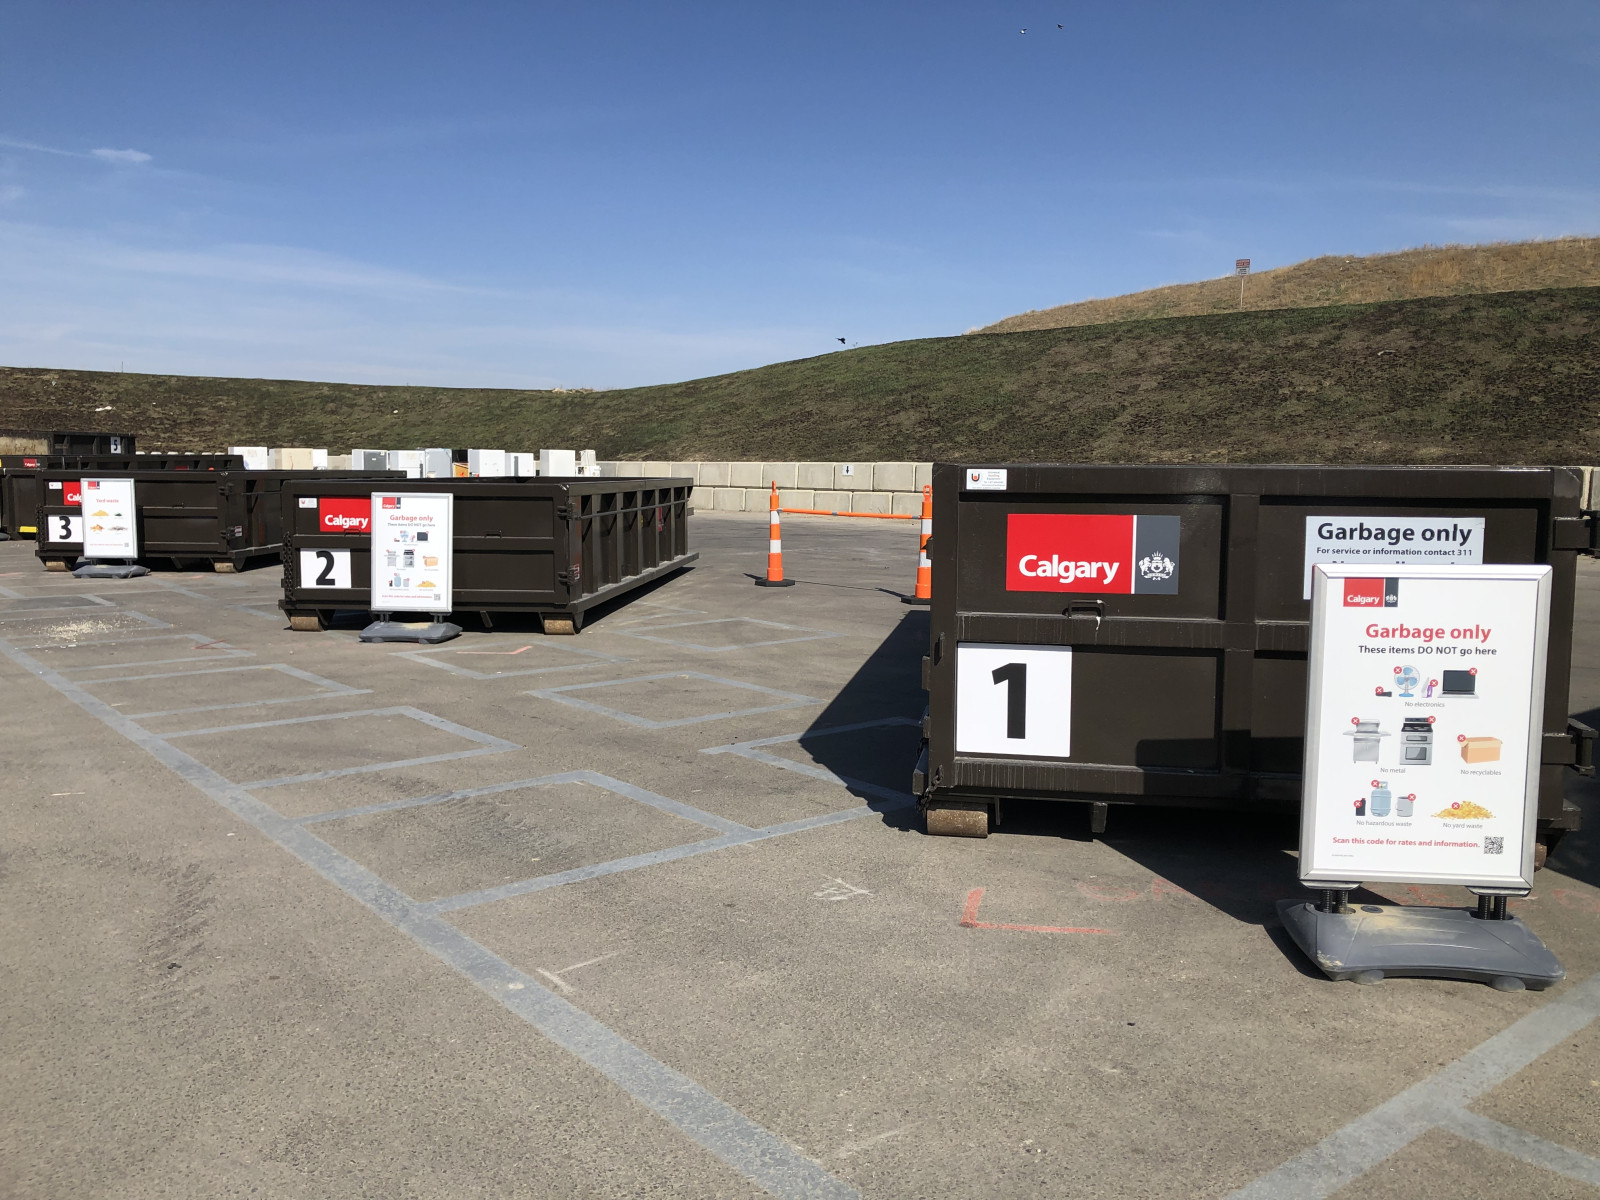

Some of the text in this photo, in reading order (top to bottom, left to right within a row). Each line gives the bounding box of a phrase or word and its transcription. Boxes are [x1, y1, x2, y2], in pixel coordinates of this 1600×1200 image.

[114, 439, 118, 452] 5
[67, 493, 82, 503] Calg
[59, 516, 72, 539] 3
[325, 514, 368, 528] Calgary
[1318, 522, 1472, 546] Garbage only
[1316, 547, 1330, 555] For
[1332, 547, 1360, 555] service
[1373, 548, 1422, 556] information
[1424, 548, 1455, 556] contact
[315, 550, 336, 586] 2
[1019, 554, 1119, 584] Calgary
[1347, 594, 1380, 604] Calgary
[1366, 623, 1492, 643] Garbage only
[1358, 645, 1497, 656] These items DO NOT go here
[991, 662, 1027, 740] 1
[1452, 822, 1464, 830] yard
[1332, 836, 1480, 848] Scan this code for rates and information.
